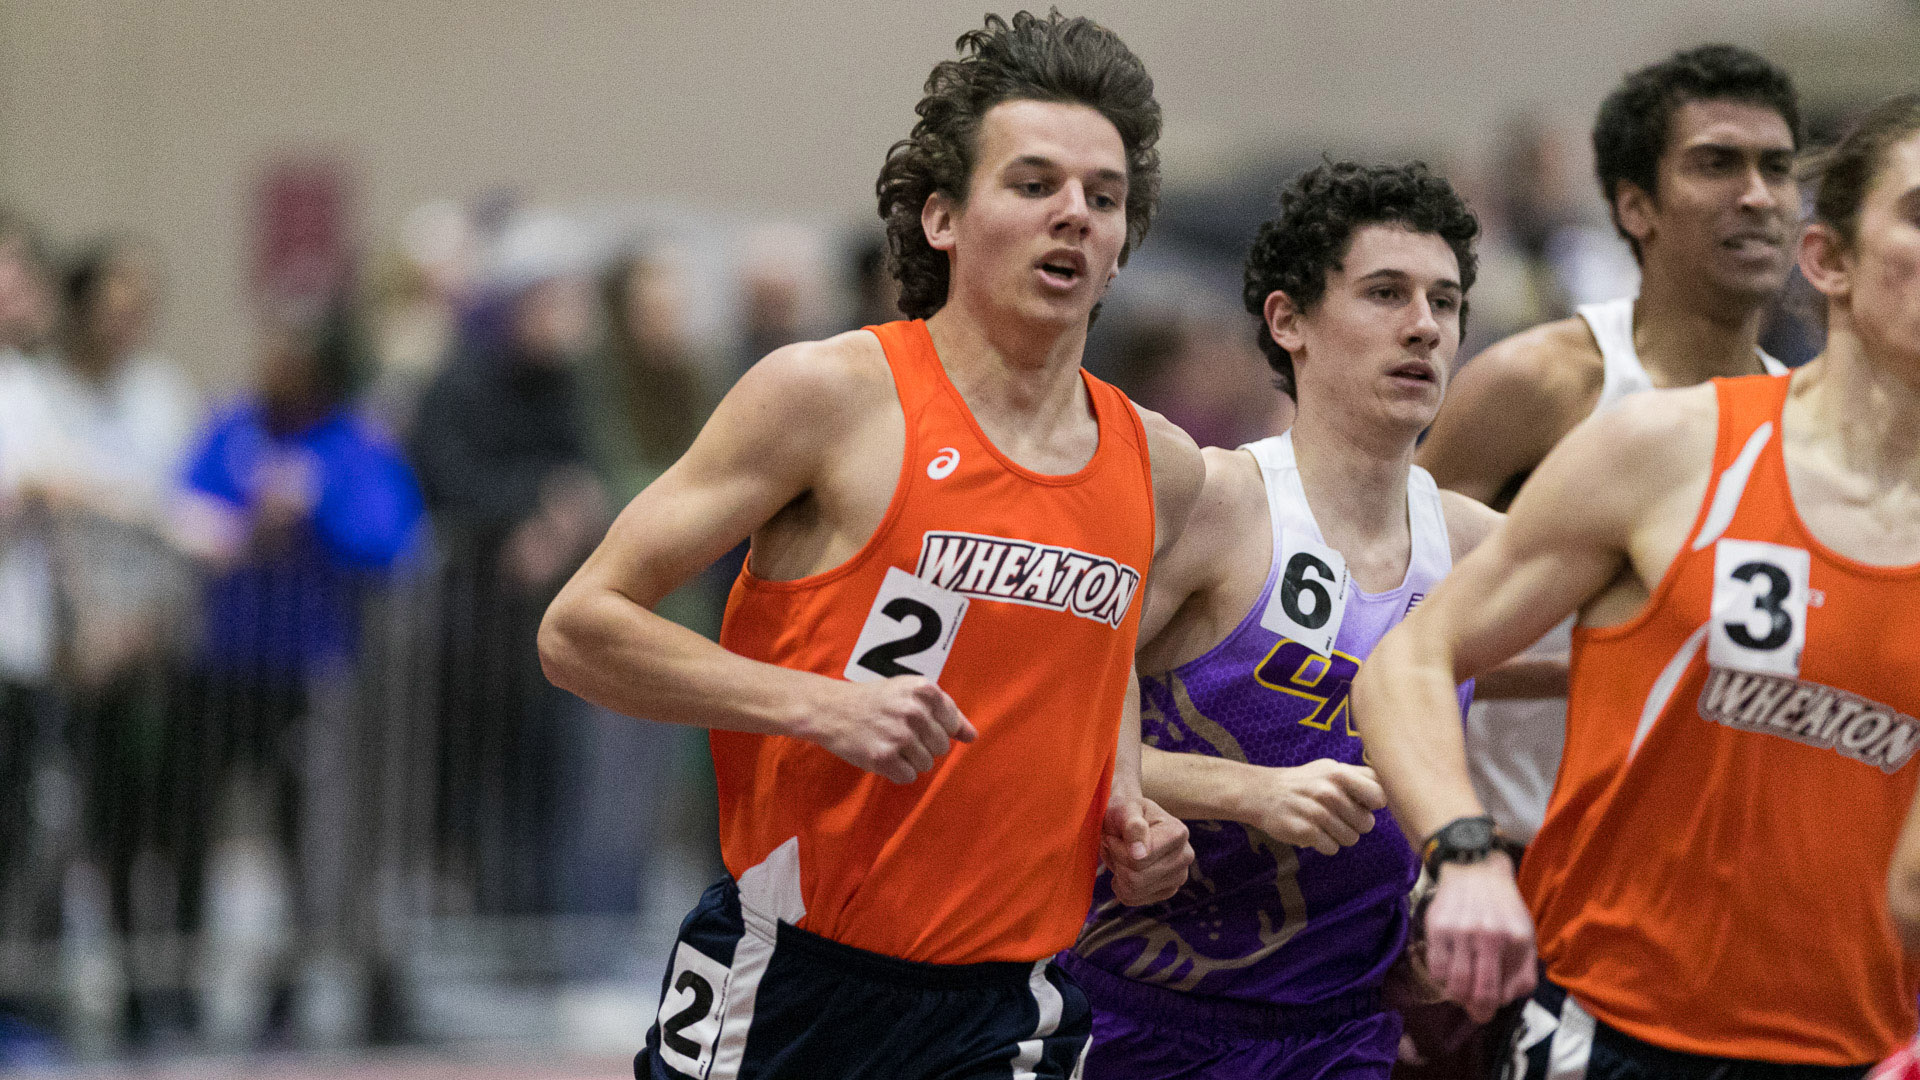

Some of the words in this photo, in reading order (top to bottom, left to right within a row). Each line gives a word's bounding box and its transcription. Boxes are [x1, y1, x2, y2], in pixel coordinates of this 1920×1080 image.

[918, 532, 1140, 628] WHEATON
[1281, 552, 1335, 629] 6
[1724, 561, 1793, 651] 3
[857, 597, 942, 678] 2
[1702, 669, 1920, 769] WHEATON
[663, 970, 713, 1061] 2
